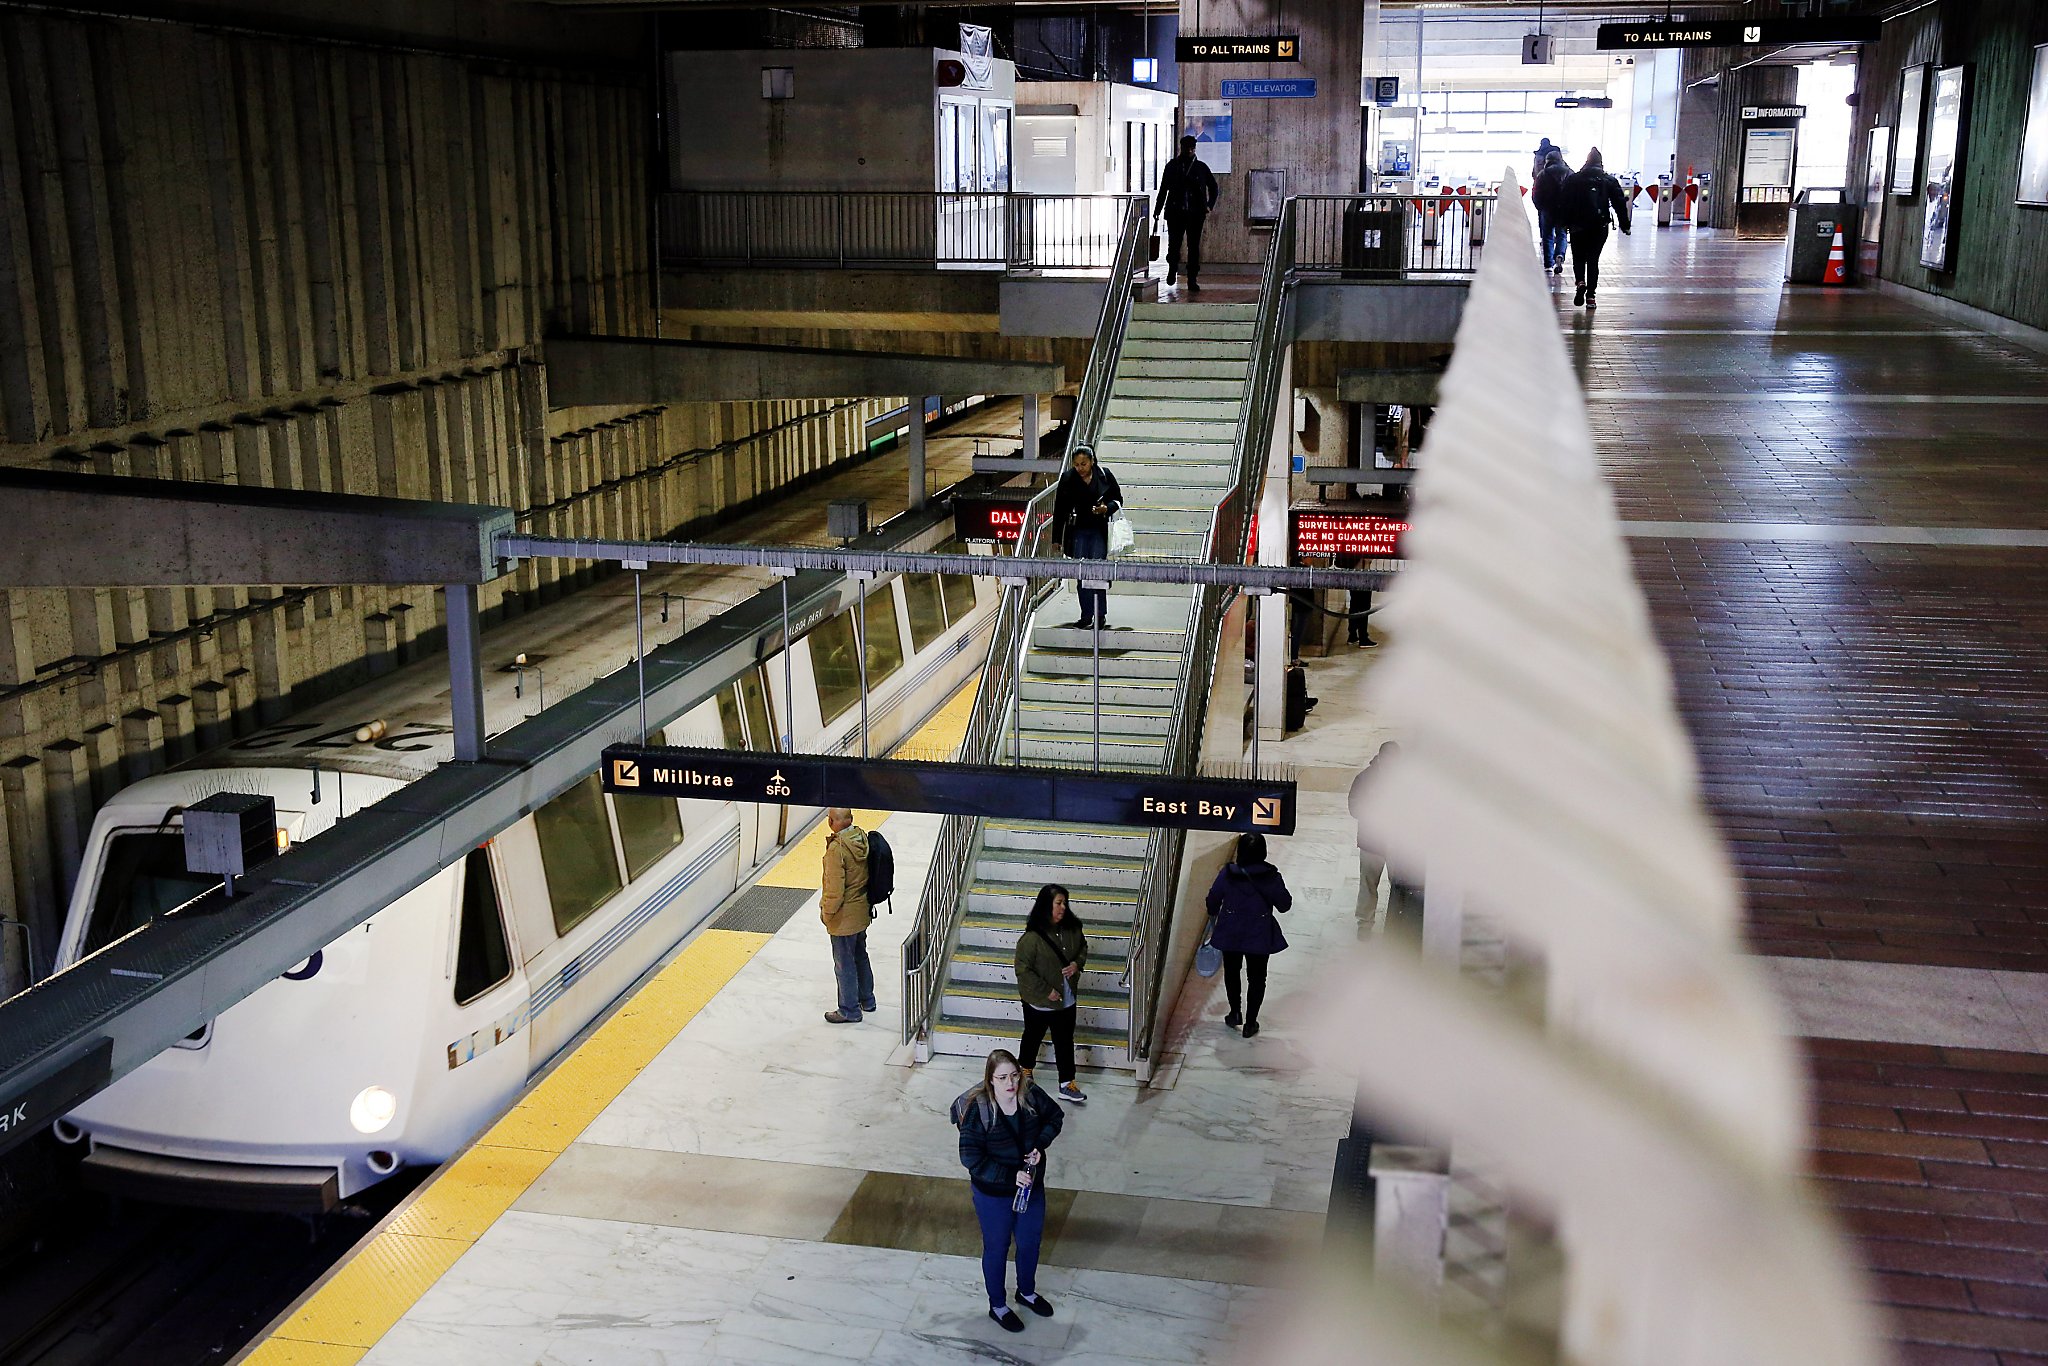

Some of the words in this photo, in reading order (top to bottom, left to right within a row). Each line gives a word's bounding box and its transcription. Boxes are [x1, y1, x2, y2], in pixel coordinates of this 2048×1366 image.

[1623, 33, 1640, 42] TO
[1643, 32, 1665, 42] ALL
[1668, 31, 1712, 41] TRAINS
[1192, 45, 1207, 55] TO
[1210, 45, 1230, 55] ALL
[1231, 44, 1271, 54] TRAINS
[1253, 84, 1297, 93] ELEVATOR
[1758, 107, 1804, 118] INFORMATION
[991, 511, 1026, 524] DALY
[1298, 521, 1371, 531] SURVEILLANCE
[1298, 532, 1318, 541] ARE
[1321, 532, 1335, 541] NO
[1337, 533, 1396, 542] GUARANTEE
[1298, 543, 1342, 552] AGAINST
[1345, 544, 1394, 553] CRIMINAL
[807, 607, 824, 626] PARK
[653, 768, 735, 788] Millbrae
[766, 784, 791, 797] SFO
[1143, 797, 1188, 815] East
[1198, 800, 1236, 820] Bay
